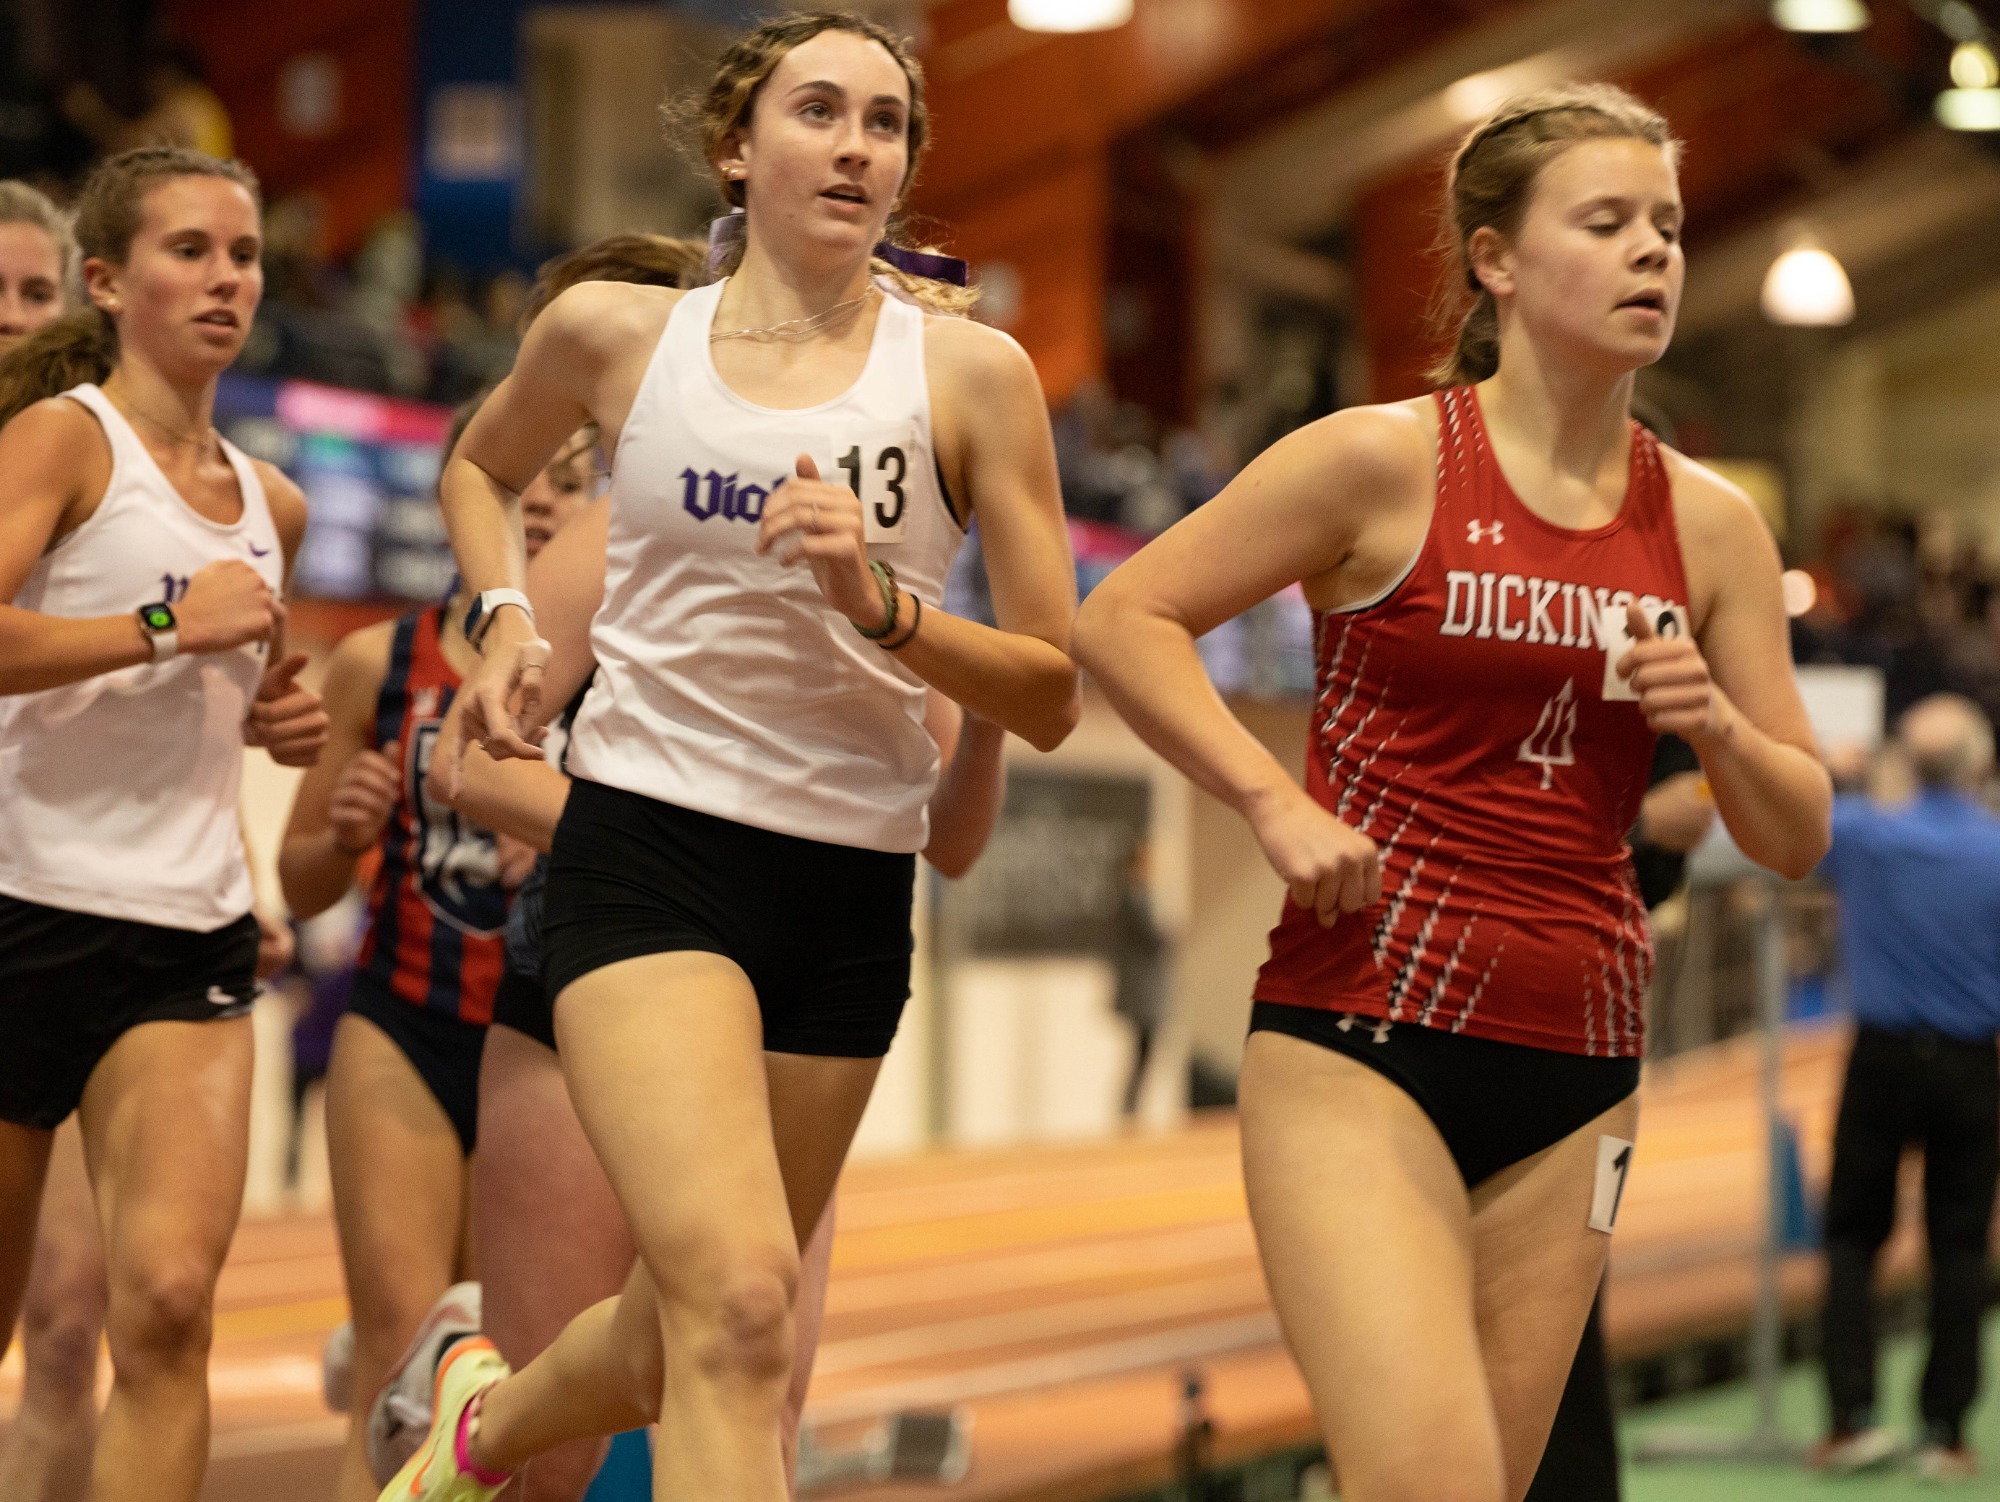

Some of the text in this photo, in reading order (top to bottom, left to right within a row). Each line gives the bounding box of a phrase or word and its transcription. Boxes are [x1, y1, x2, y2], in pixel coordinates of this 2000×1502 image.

[678, 466, 788, 524] Vio
[837, 445, 907, 529] 13
[1440, 569, 1675, 651] DICKIN
